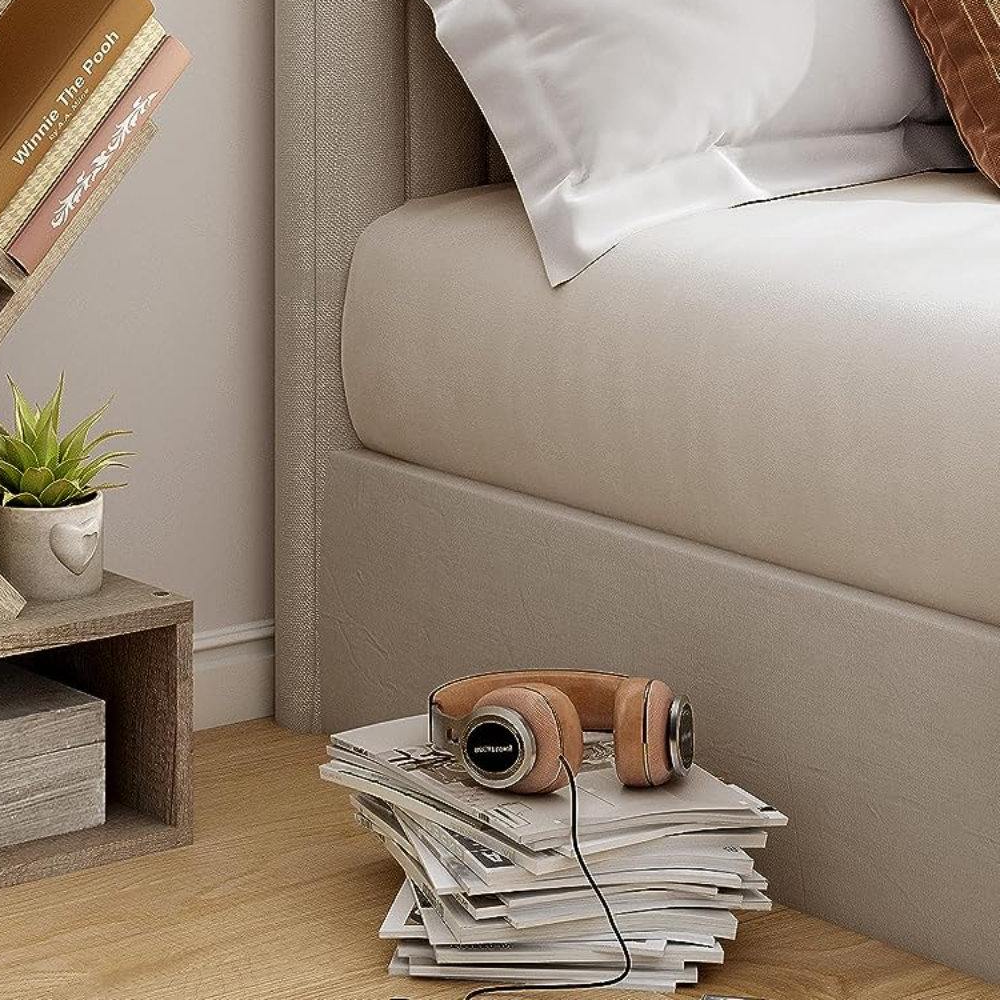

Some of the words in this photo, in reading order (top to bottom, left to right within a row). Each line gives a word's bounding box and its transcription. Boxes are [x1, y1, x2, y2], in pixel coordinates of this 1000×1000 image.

[10, 106, 61, 166] Winnie
[55, 72, 86, 108] The
[81, 28, 120, 75] Pooh
